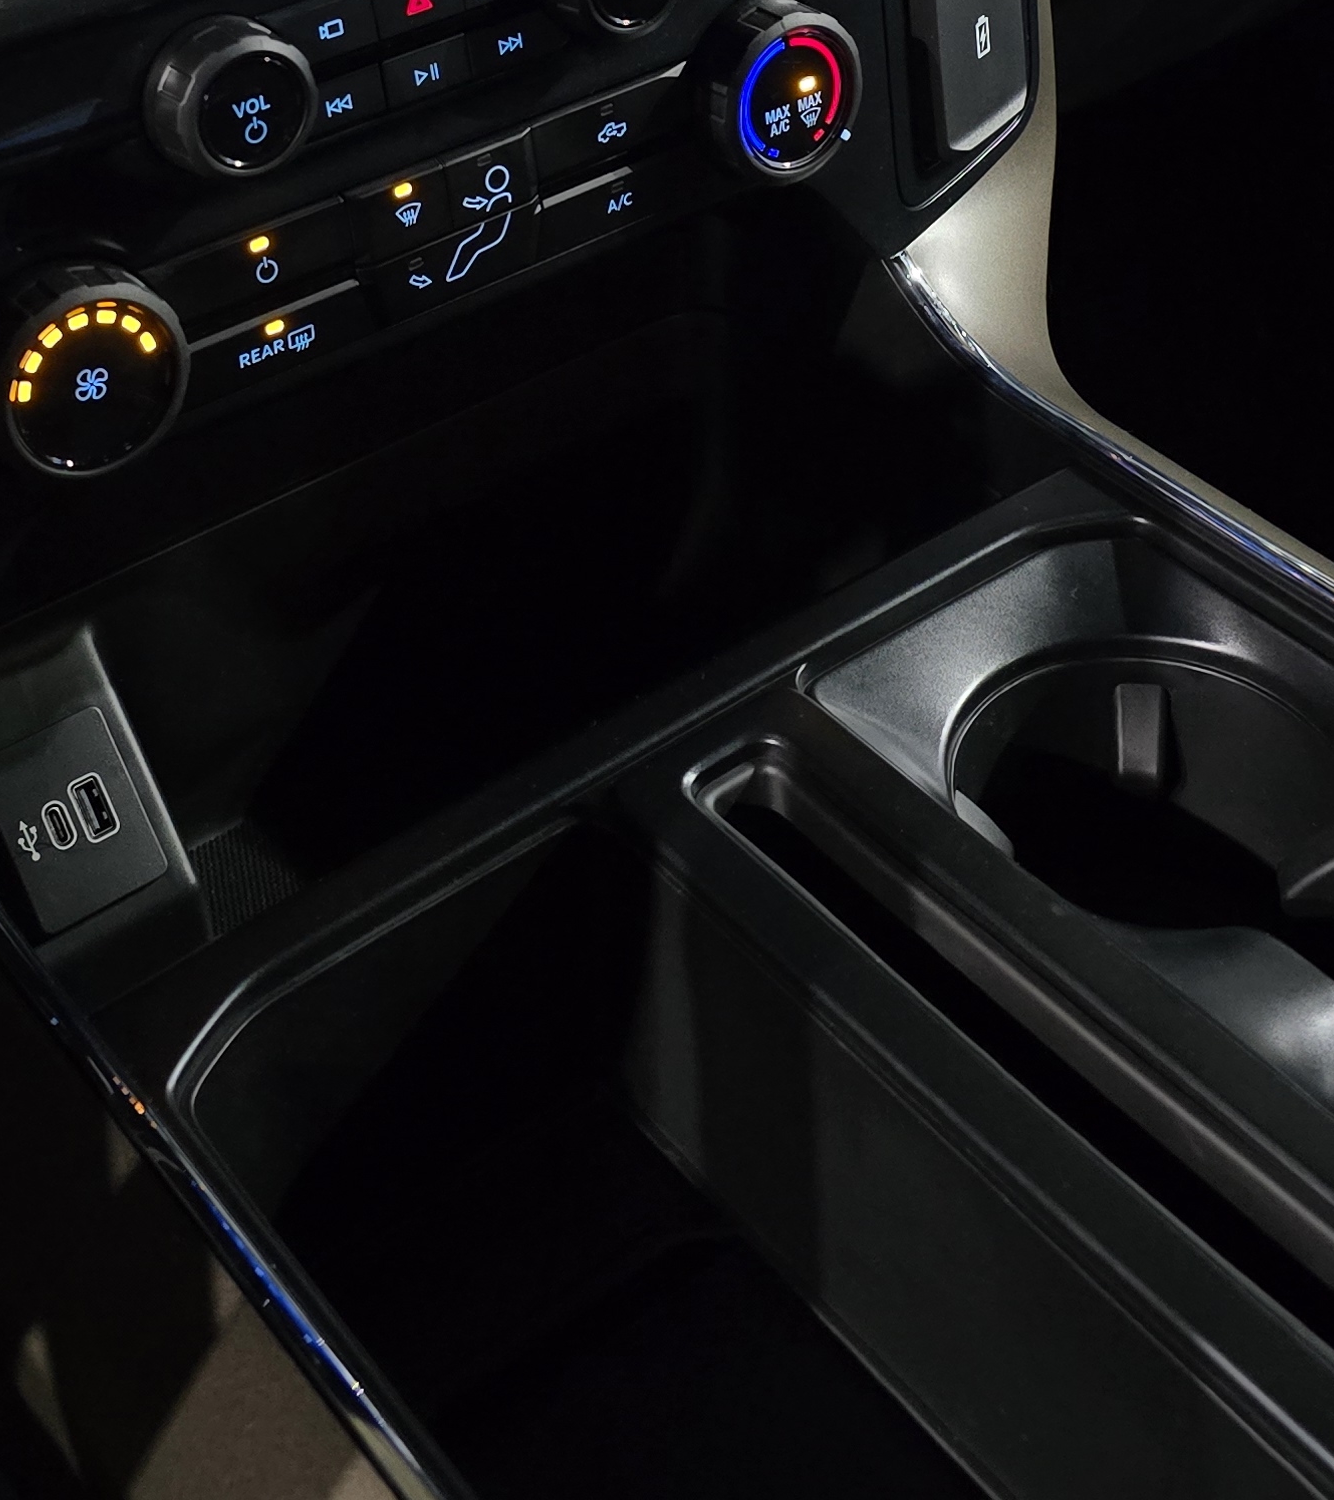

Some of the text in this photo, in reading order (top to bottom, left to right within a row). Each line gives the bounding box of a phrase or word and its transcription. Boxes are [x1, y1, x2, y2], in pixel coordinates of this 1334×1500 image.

[232, 94, 271, 119] VOL
[797, 90, 823, 112] MAX
[765, 104, 791, 125] MAX
[770, 119, 790, 138] A/C
[606, 192, 634, 214] A/C
[239, 338, 285, 369] REAR
